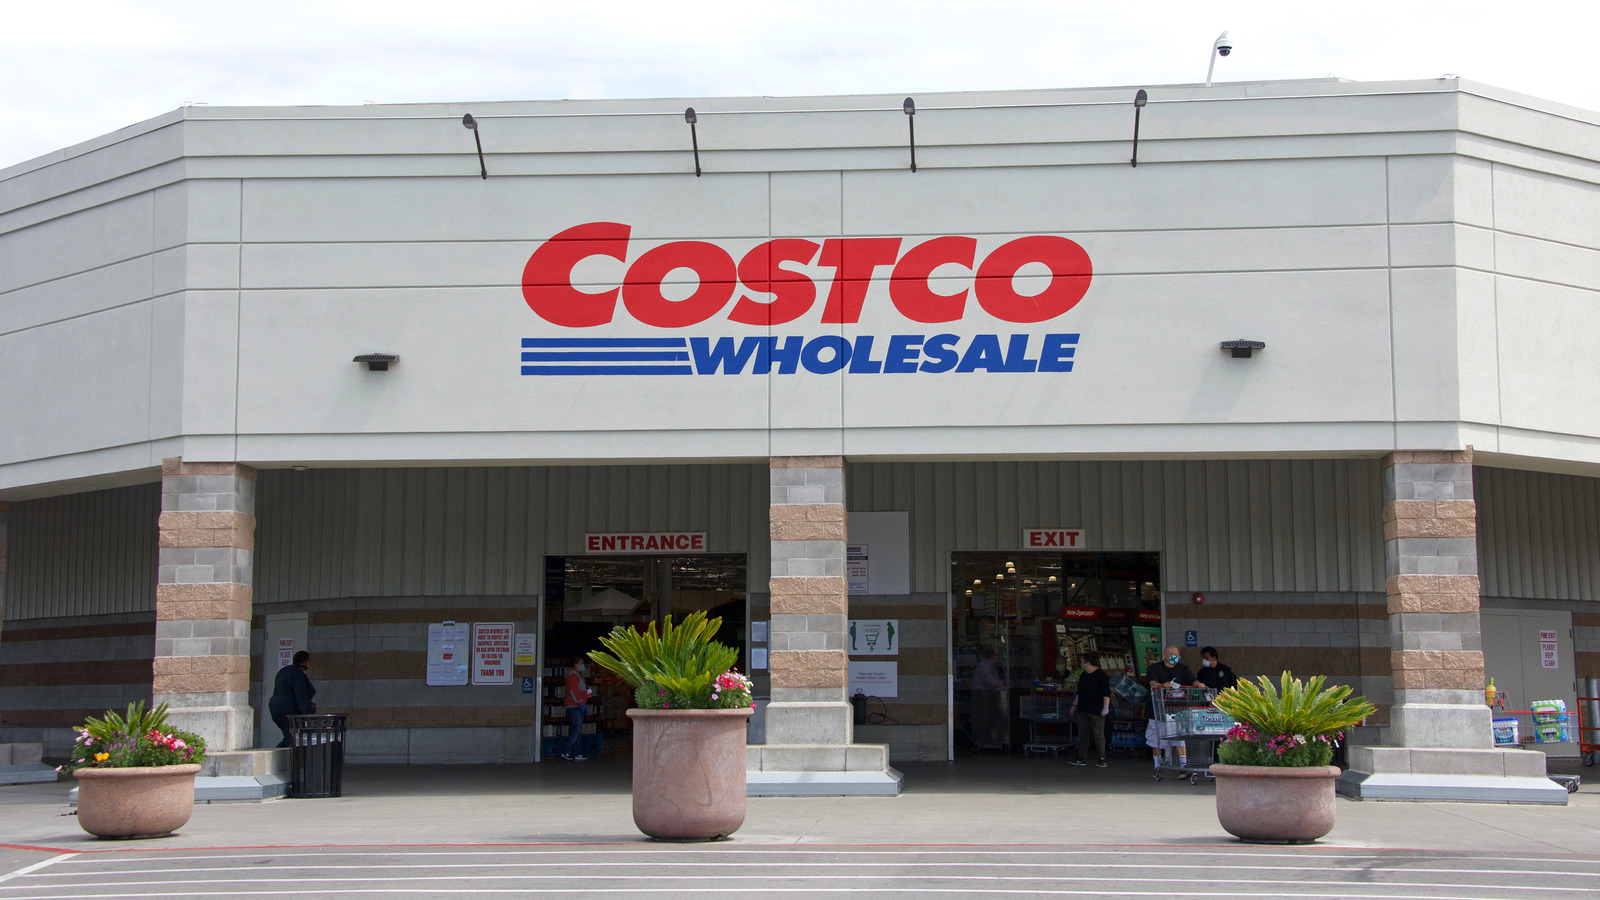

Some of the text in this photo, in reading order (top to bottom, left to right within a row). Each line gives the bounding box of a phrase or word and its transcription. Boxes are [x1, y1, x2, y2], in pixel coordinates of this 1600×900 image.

[522, 221, 1093, 328] COSTCO
[688, 333, 1080, 375] WHOLESALE
[588, 535, 704, 551] ENTRANCE
[1030, 531, 1079, 546] EXIT
